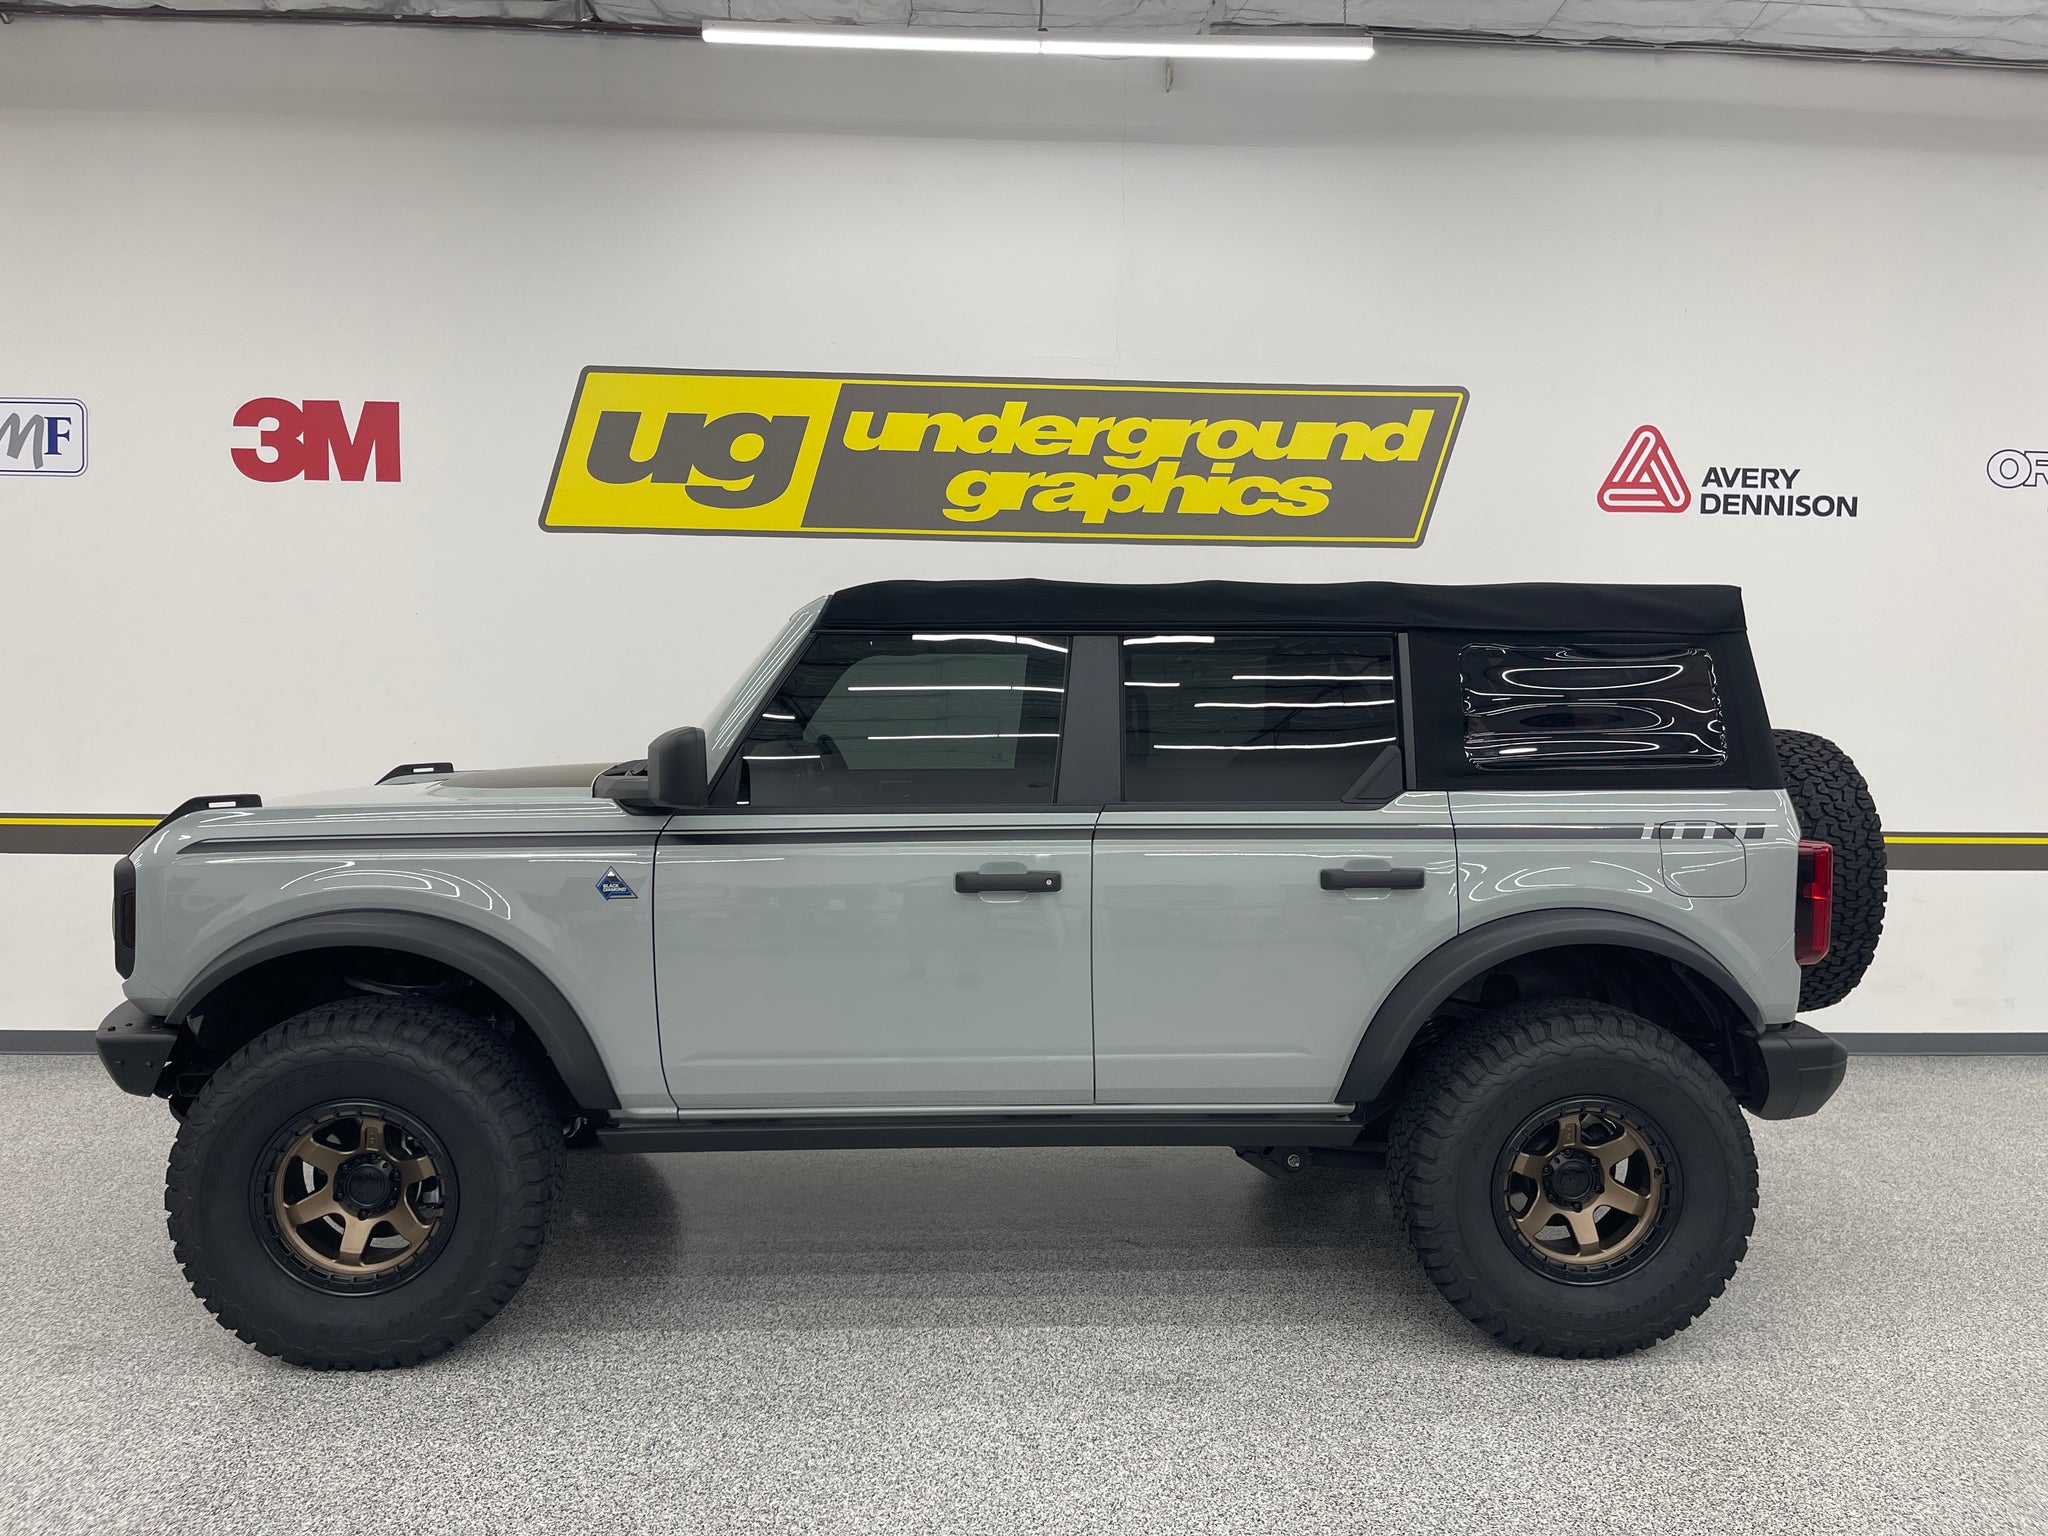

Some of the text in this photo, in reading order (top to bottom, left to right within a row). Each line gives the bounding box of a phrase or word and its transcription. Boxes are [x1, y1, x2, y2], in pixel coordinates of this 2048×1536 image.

[230, 398, 401, 483] 3M
[587, 410, 810, 509] ug
[842, 400, 1435, 470] underground
[942, 460, 1333, 525] graphics
[1700, 493, 1858, 518] DENNISON
[1701, 466, 1801, 490] AVERY
